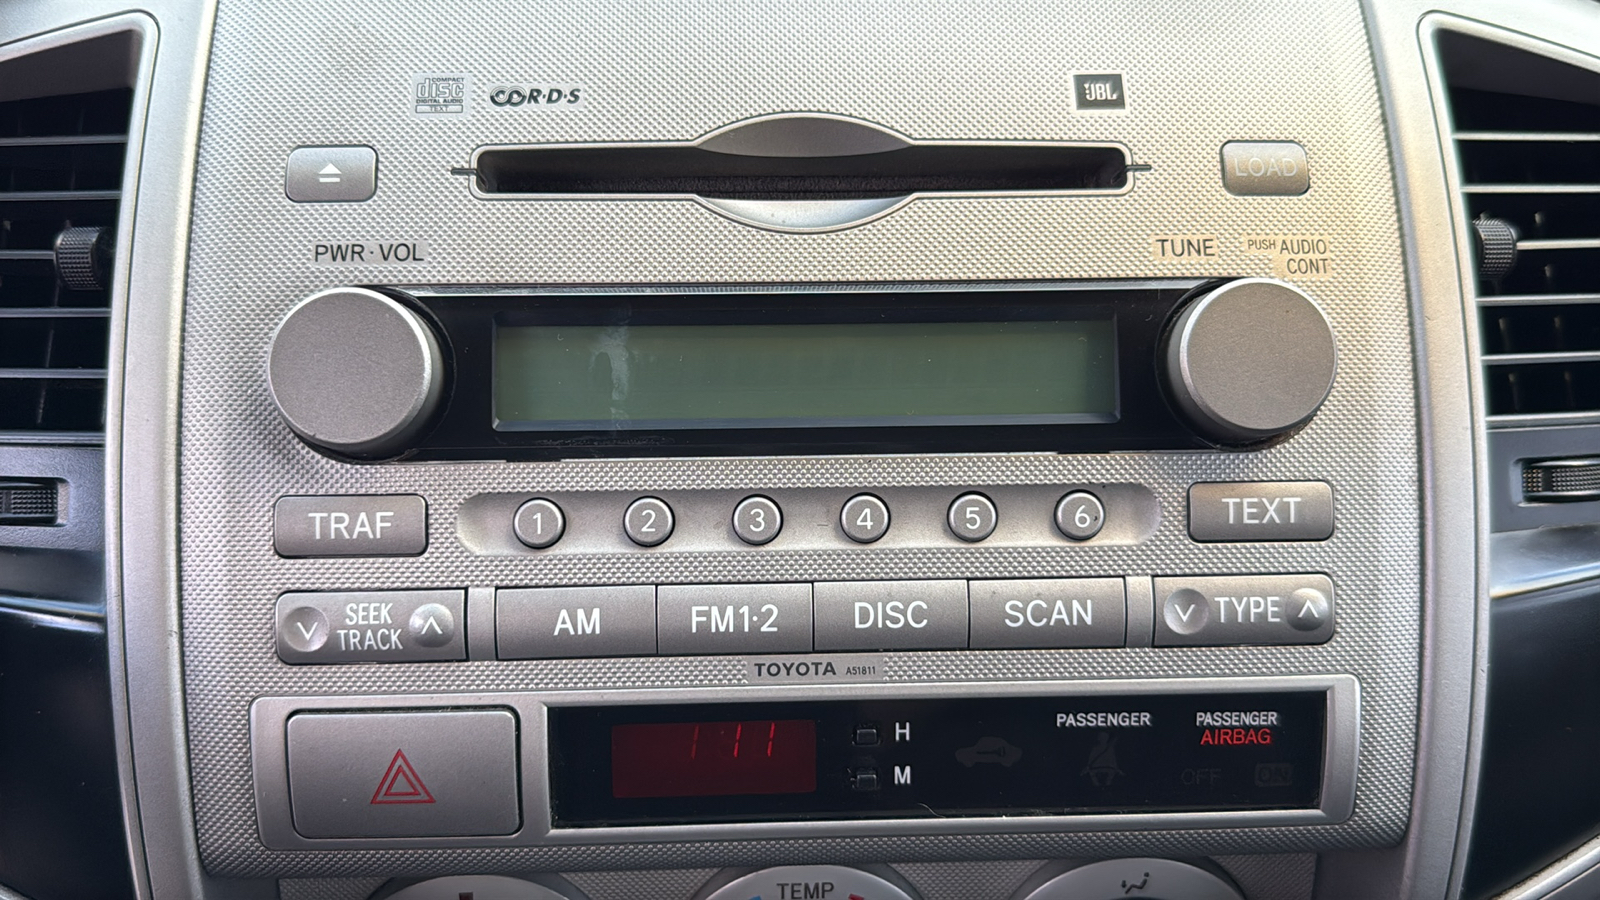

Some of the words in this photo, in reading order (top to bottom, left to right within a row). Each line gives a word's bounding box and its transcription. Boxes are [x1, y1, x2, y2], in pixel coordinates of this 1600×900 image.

[416, 77, 465, 98] disc
[1085, 83, 1117, 101] JBL
[1234, 157, 1298, 177] LOAD
[1155, 238, 1216, 257] TUNE
[1248, 239, 1277, 250] PUSH
[1279, 238, 1327, 255] AUDIO
[1286, 258, 1328, 275] CONT
[640, 509, 656, 532] 2
[749, 508, 766, 532] 3
[856, 507, 874, 530] 4
[965, 506, 981, 530] 5
[1074, 505, 1091, 528] 6
[1221, 497, 1302, 525] TEXT
[308, 511, 394, 540] TRAF
[531, 511, 542, 535] 1
[345, 602, 393, 625] SEEK
[853, 600, 929, 629] DISC
[1004, 599, 1093, 628] SCAN
[1214, 596, 1281, 623] TYPE
[553, 607, 600, 637] AM
[337, 628, 403, 651] TRACK
[754, 661, 837, 677] TOYOTA
[845, 666, 876, 675] A51811
[1056, 712, 1151, 728] PASSENGER
[1195, 711, 1278, 726] PASSENGER
[894, 722, 910, 741] H
[1200, 728, 1271, 746] AIRBAG
[893, 766, 911, 785] M
[1181, 767, 1222, 786] OFF
[776, 882, 834, 900] TEMP
